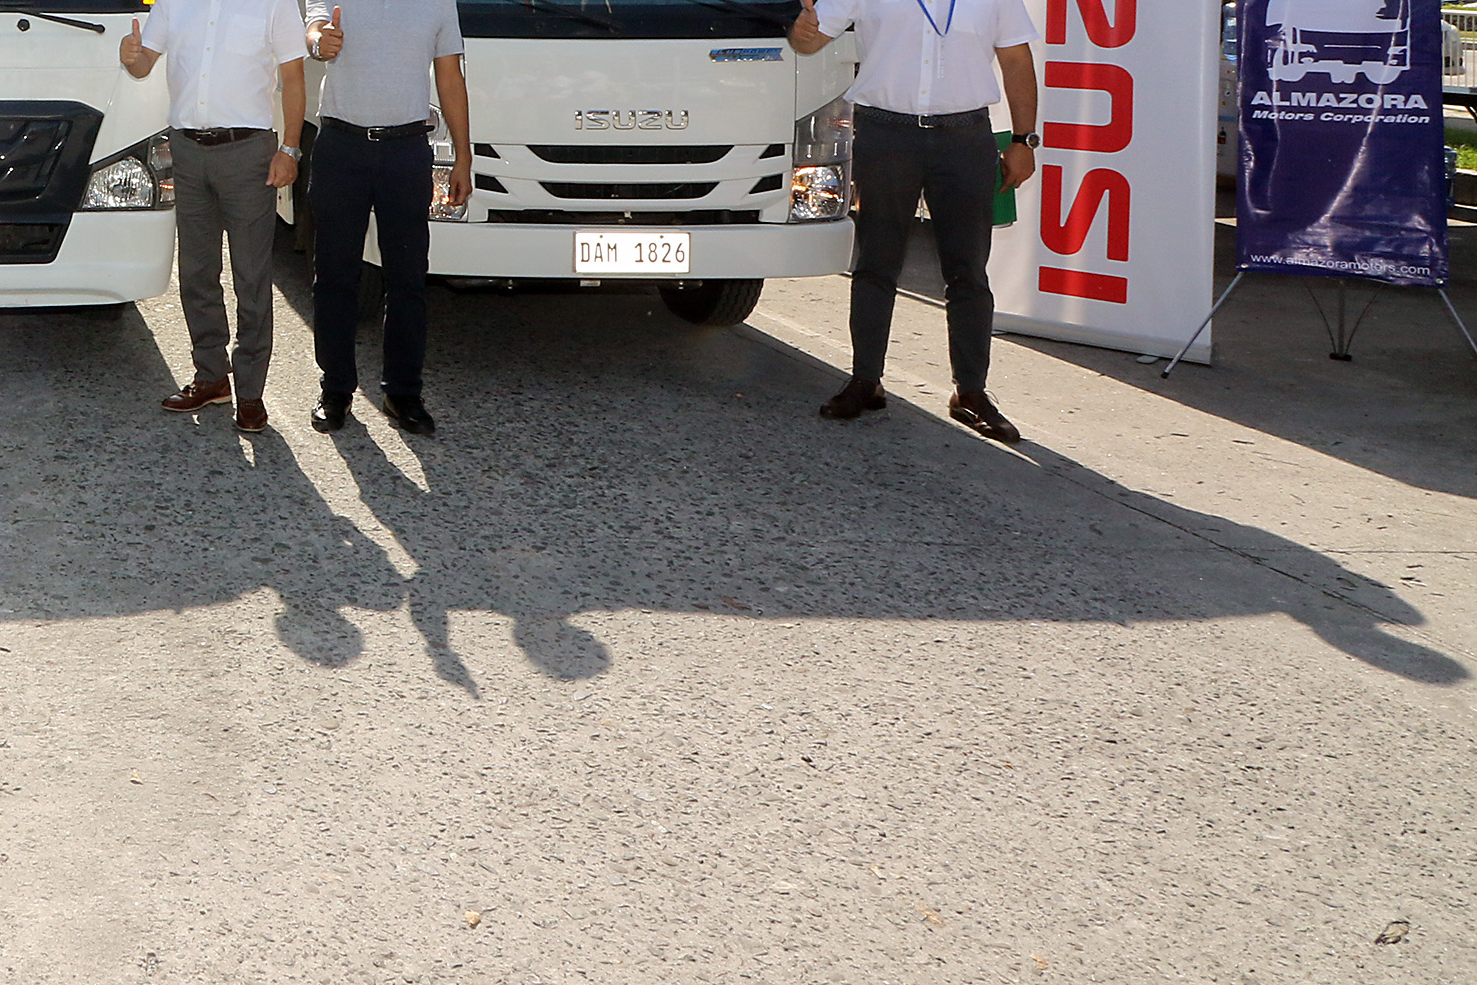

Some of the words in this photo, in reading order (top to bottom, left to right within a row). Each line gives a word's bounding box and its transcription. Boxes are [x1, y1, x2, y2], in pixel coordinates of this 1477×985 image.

[1251, 91, 1428, 109] ALMAZORA
[575, 110, 689, 130] ISUZU
[1252, 110, 1314, 121] Motors
[1320, 112, 1430, 124] Corporation
[580, 242, 617, 262] DAM
[634, 242, 685, 263] 1826
[1250, 254, 1430, 275] www.almazoramotors.com
